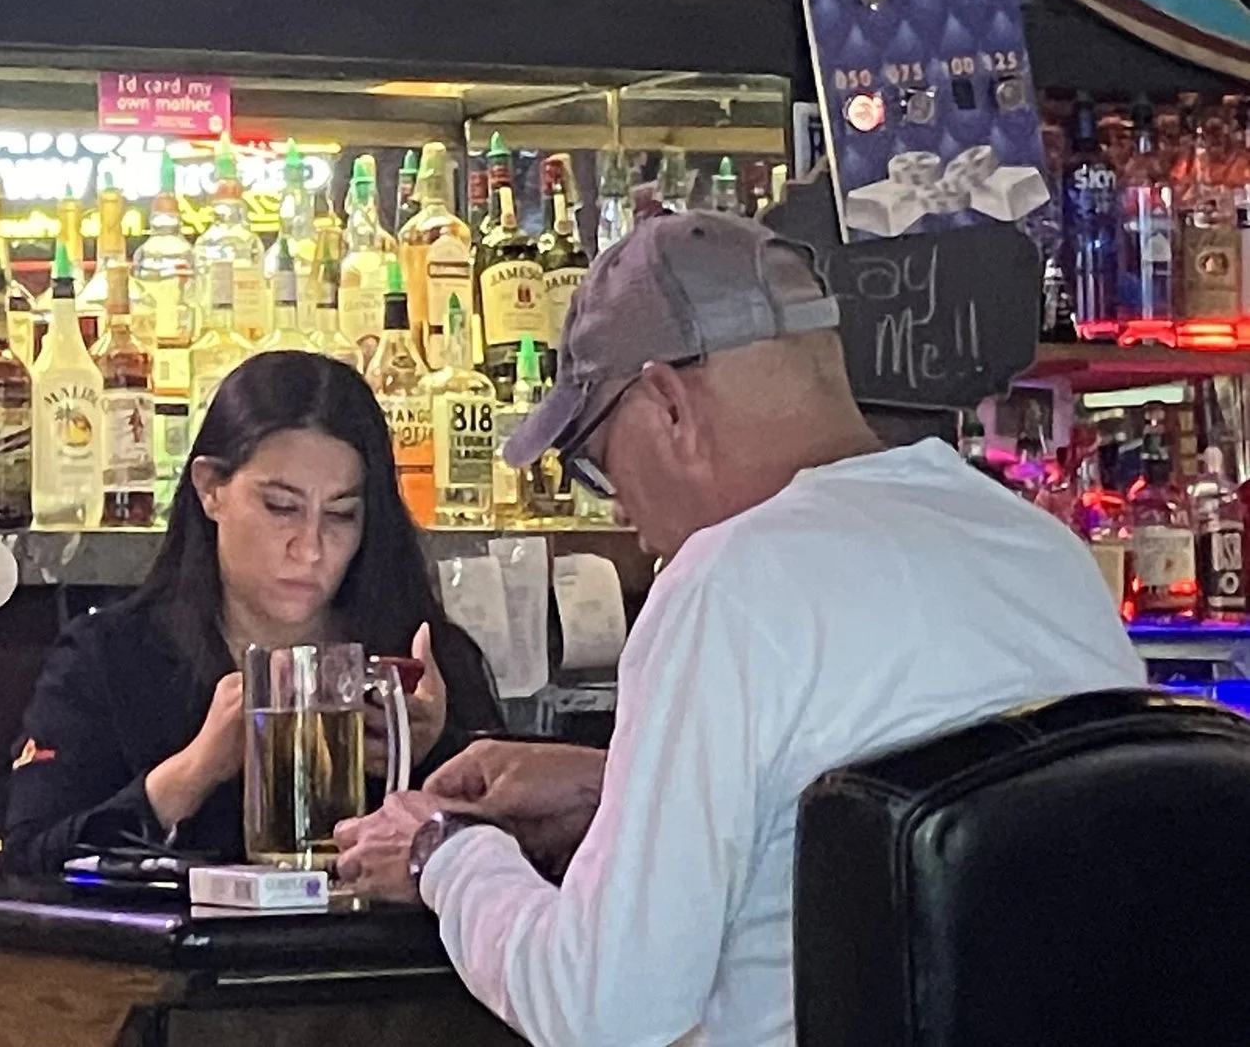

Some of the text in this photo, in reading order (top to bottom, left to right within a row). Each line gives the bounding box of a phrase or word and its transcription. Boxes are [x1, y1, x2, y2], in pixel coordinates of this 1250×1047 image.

[144, 77, 181, 94] card
[188, 82, 213, 96] my
[117, 97, 150, 110] own
[452, 402, 493, 433] 818
